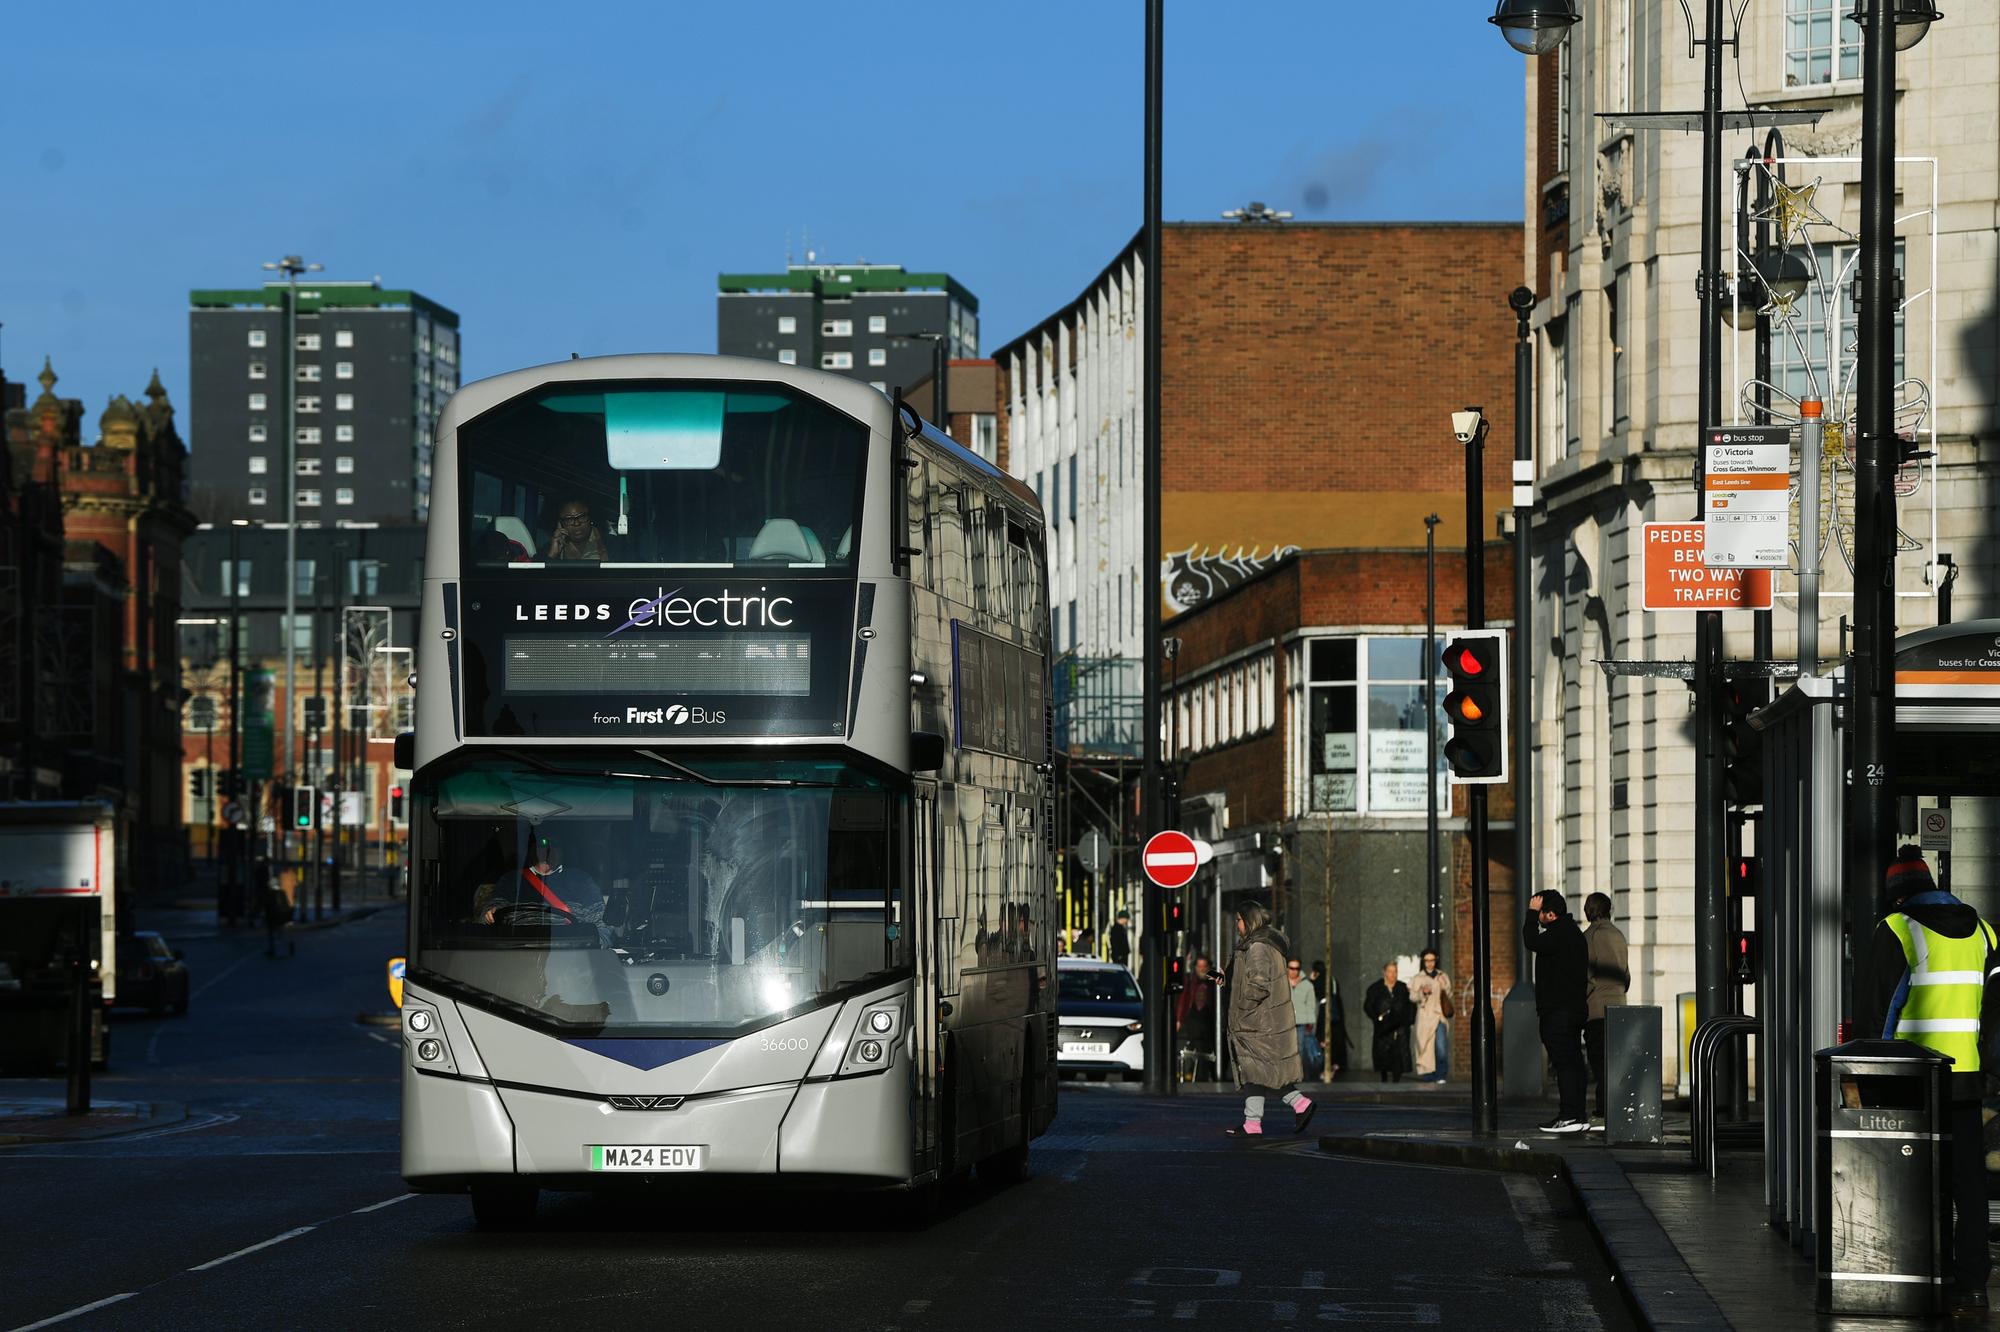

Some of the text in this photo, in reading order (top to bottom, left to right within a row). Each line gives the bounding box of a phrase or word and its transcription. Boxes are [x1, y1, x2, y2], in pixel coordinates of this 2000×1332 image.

[1733, 434, 1746, 442] bus
[1748, 434, 1764, 444] stop
[1724, 448, 1754, 456] Victoria
[1650, 530, 1704, 543] PEDES
[1669, 568, 1745, 582] TWO WAY
[1674, 588, 1742, 601] TRAFFIC
[516, 586, 793, 627] LEEDS electric
[1938, 658, 2000, 666] buses for Cross
[593, 706, 726, 726] from First Bus
[1866, 763, 1885, 777] 24
[760, 1037, 809, 1052] 36600
[1859, 1115, 1904, 1130] Litter
[606, 1149, 696, 1167] MA24 EOV
